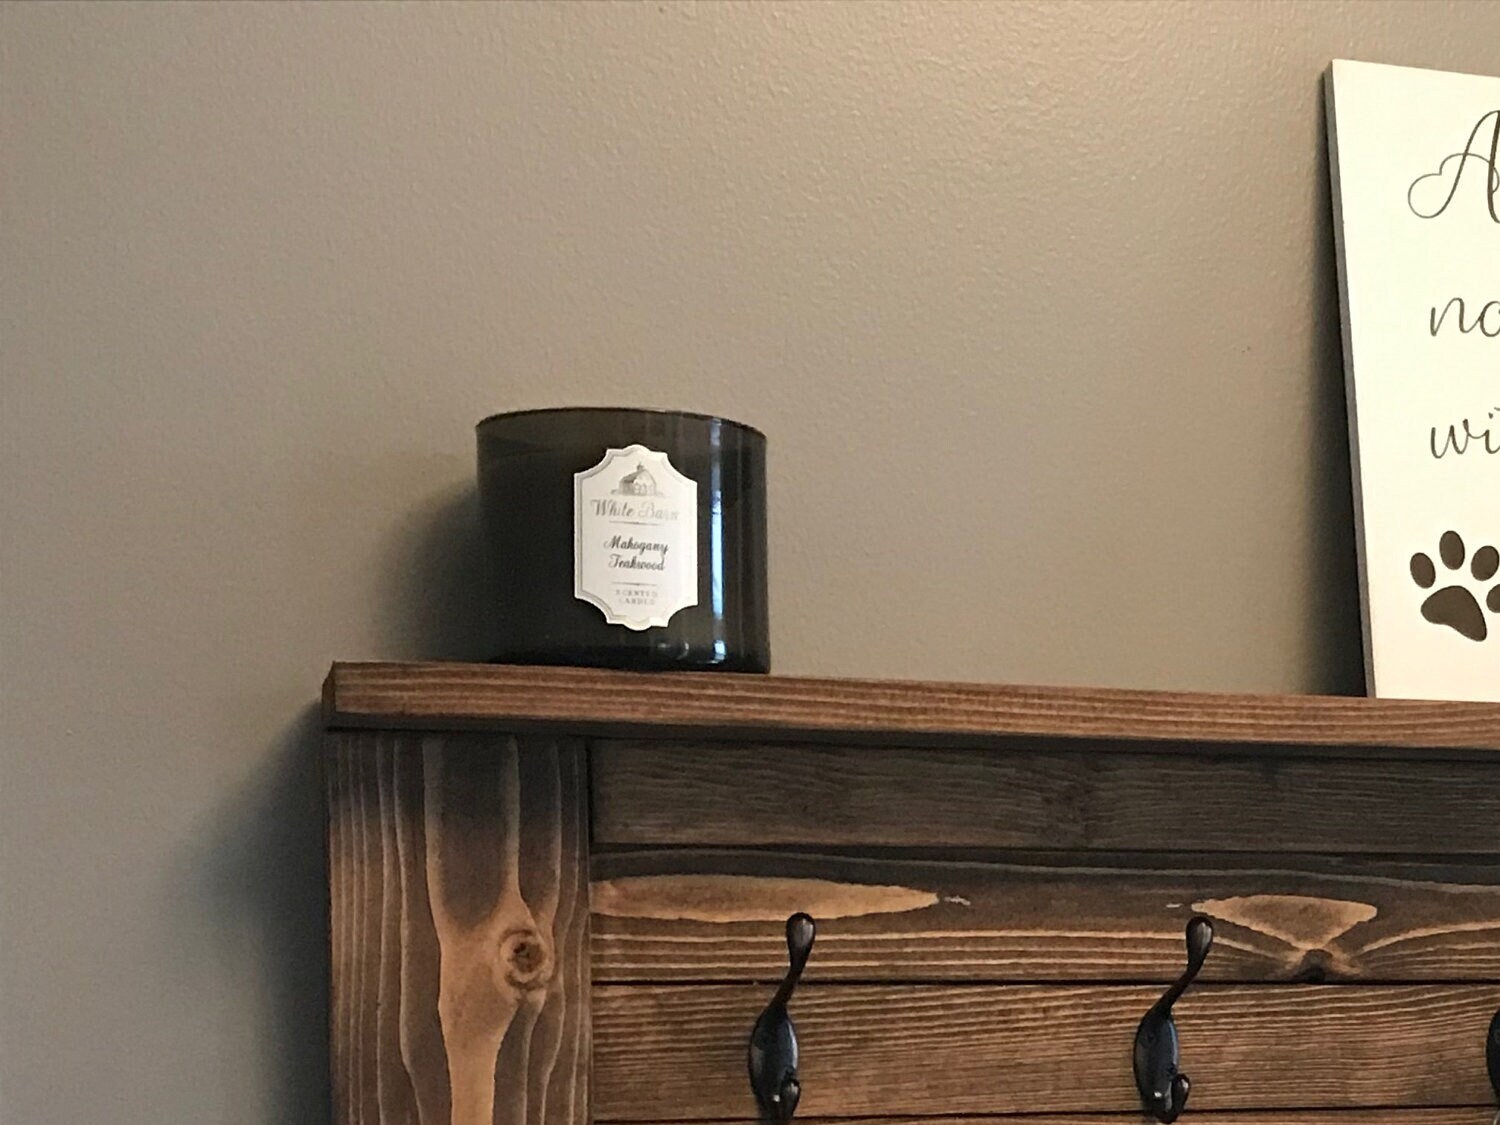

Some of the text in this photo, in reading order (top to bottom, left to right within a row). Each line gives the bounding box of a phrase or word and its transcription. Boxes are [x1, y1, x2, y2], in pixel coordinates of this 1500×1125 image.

[591, 499, 680, 521] White Barn
[603, 535, 670, 555] Mahogany
[608, 553, 665, 571] Teakwood
